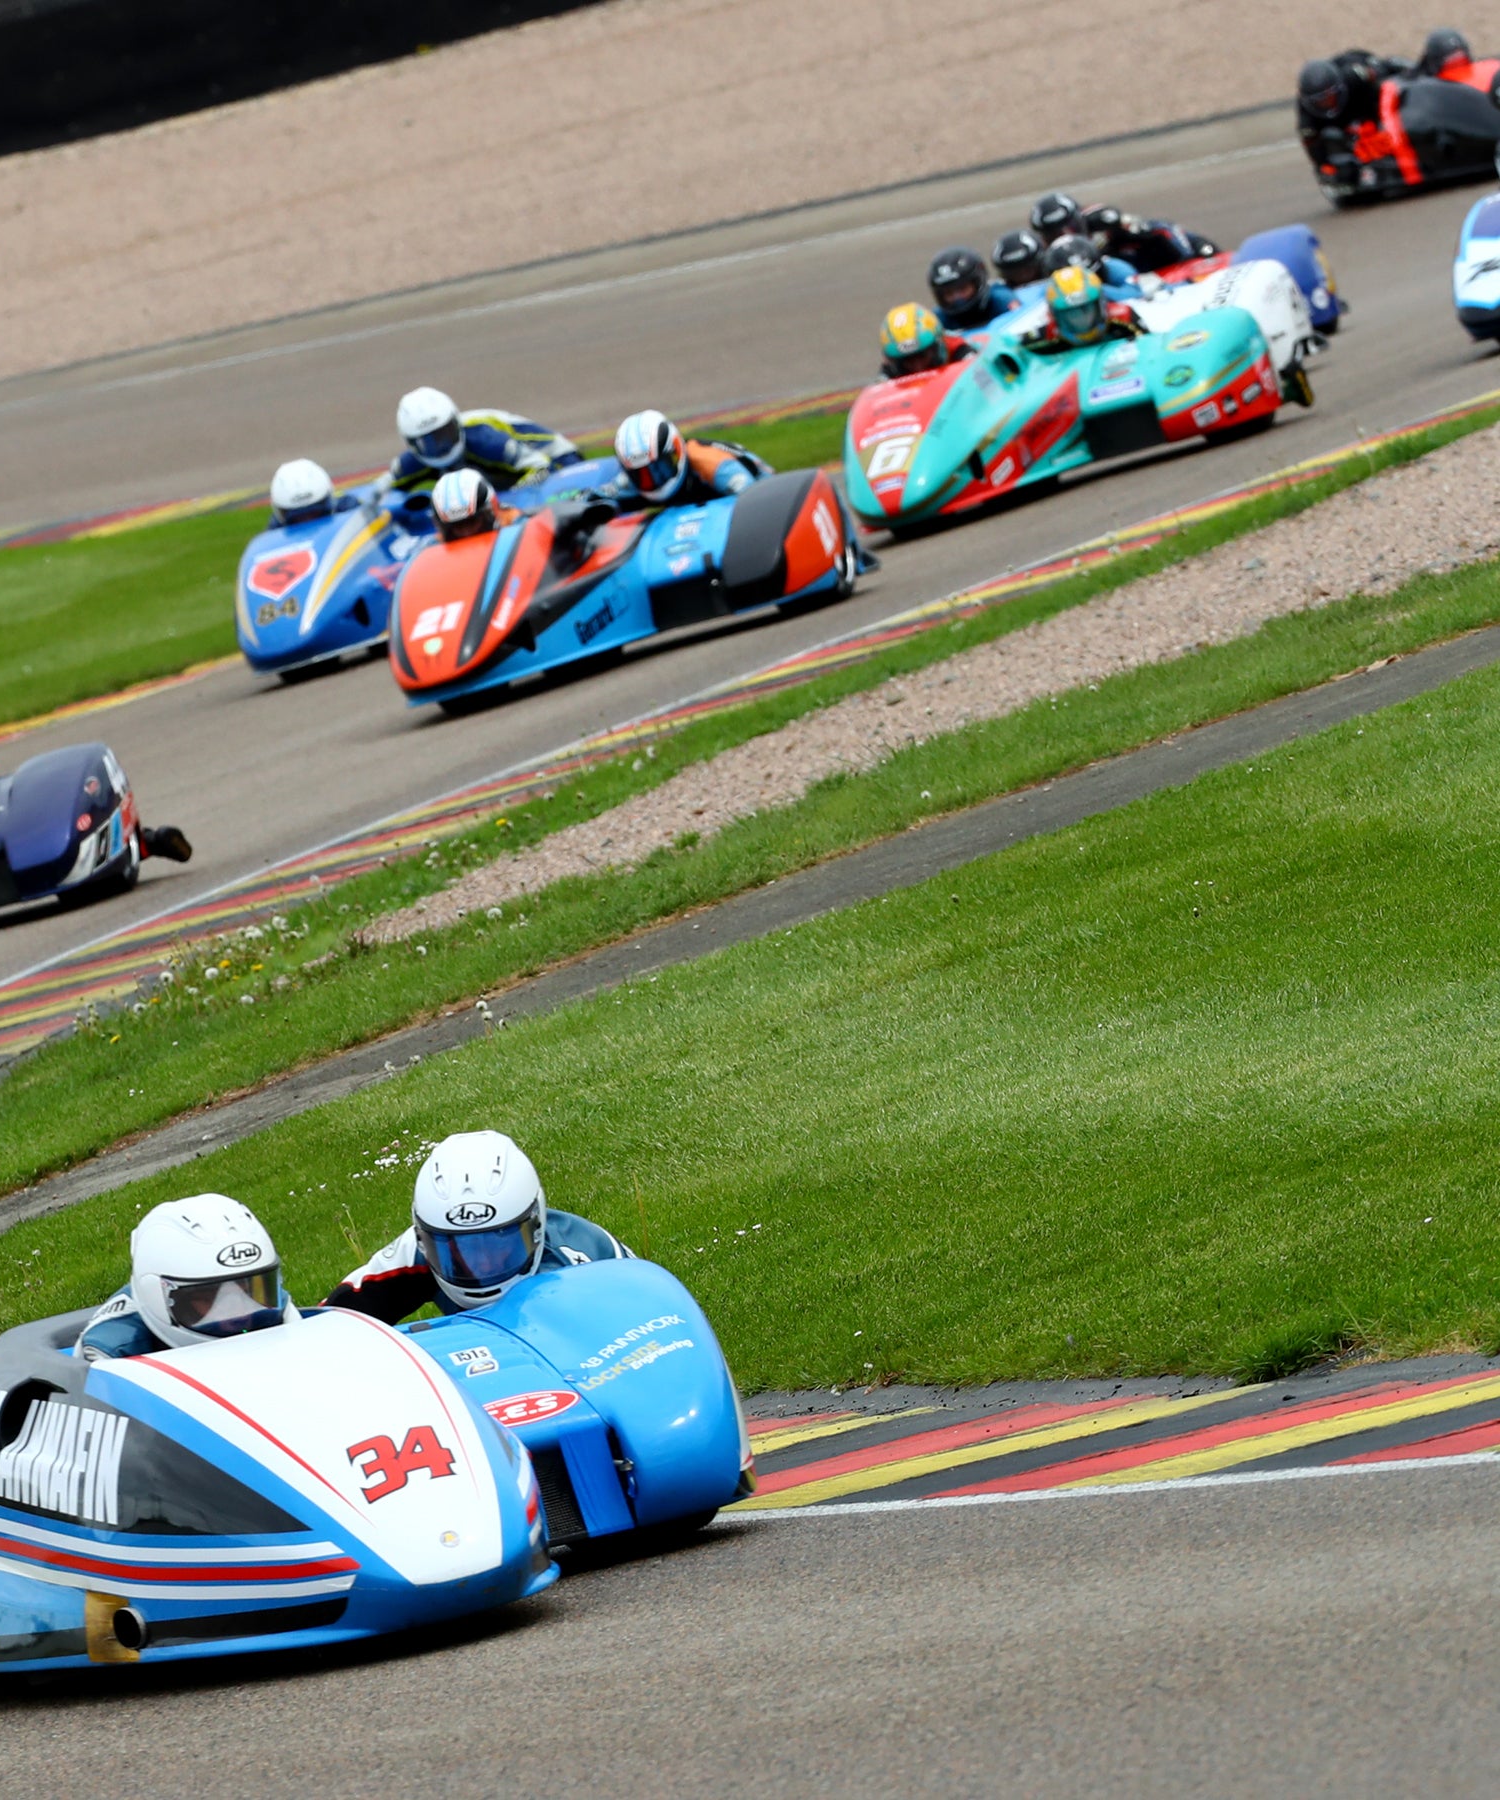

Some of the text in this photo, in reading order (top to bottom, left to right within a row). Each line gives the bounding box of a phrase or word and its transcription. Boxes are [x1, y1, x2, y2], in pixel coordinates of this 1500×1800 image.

[866, 436, 916, 479] 6
[409, 600, 465, 642] 21
[599, 1314, 686, 1359] PAINTWORK
[630, 1338, 694, 1371] Engineering
[577, 1340, 662, 1391] LOCKSIDE
[346, 1425, 457, 1505] 34
